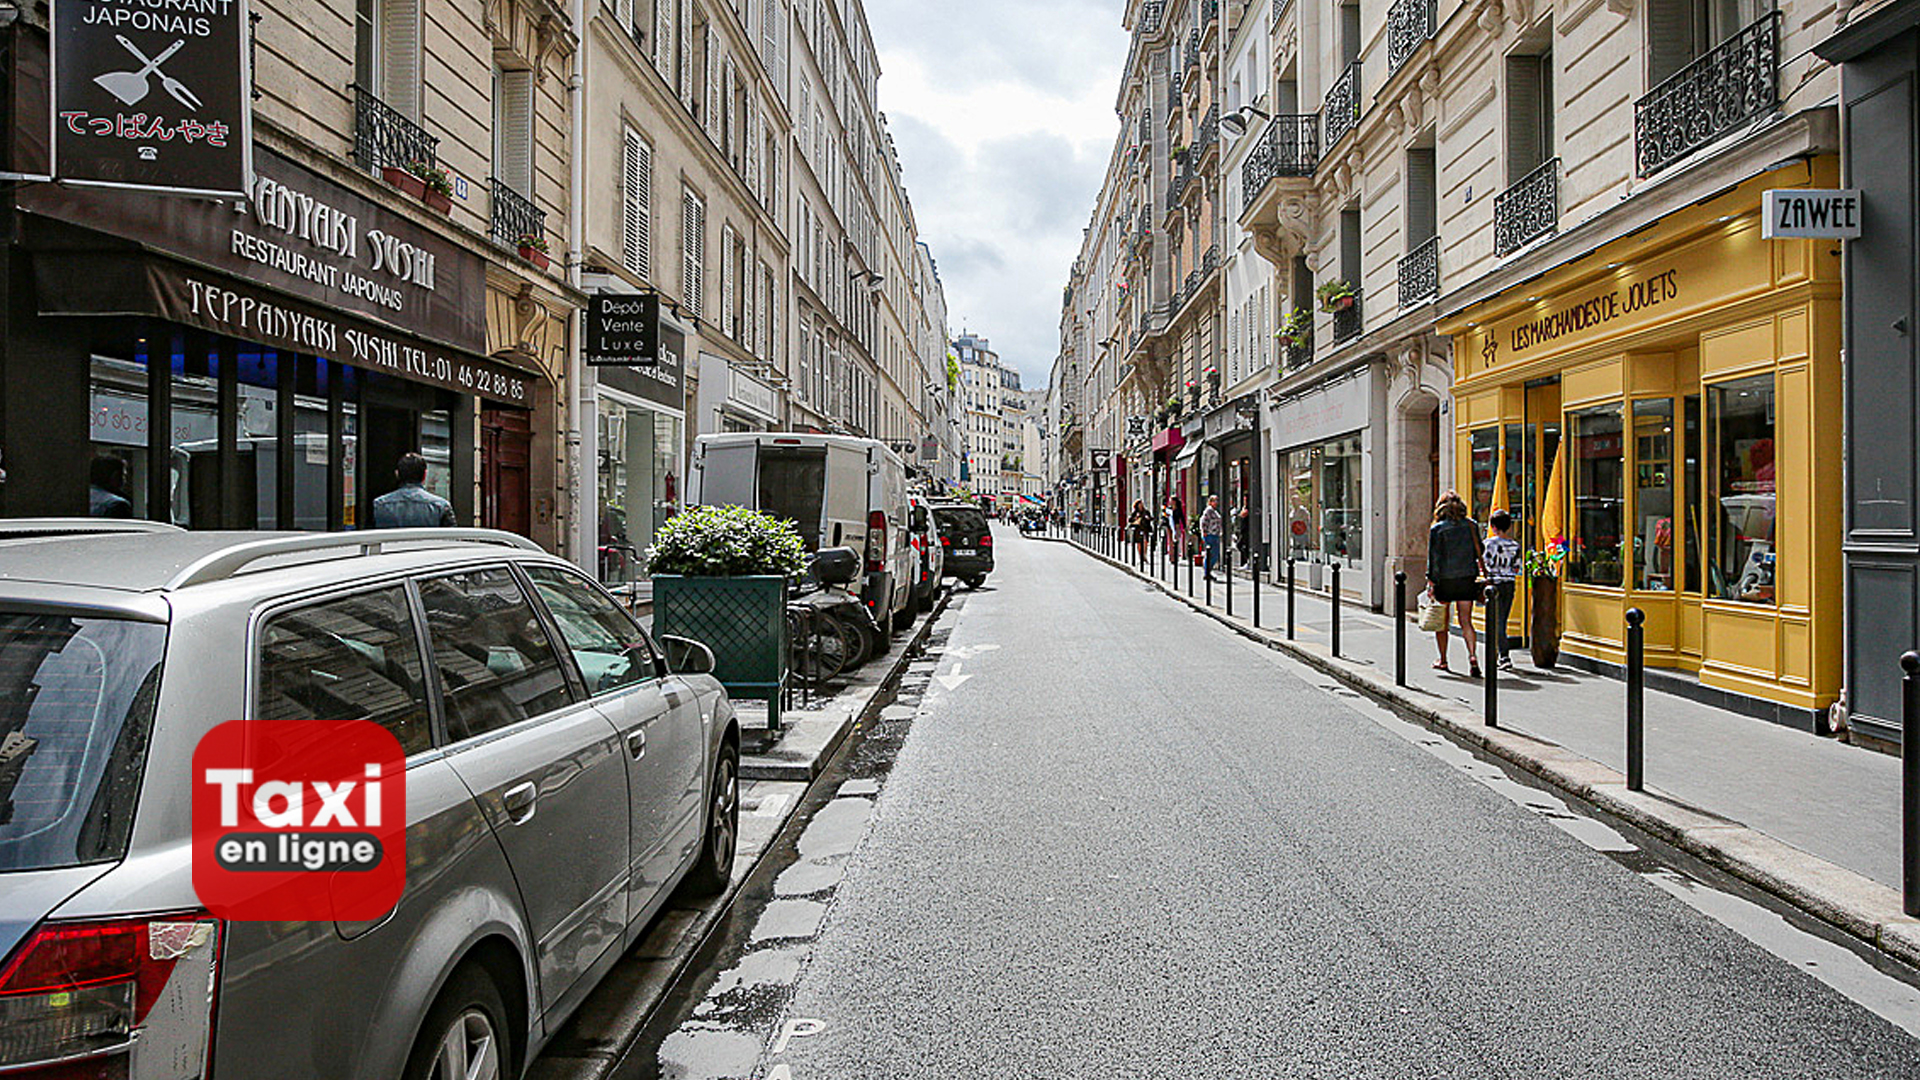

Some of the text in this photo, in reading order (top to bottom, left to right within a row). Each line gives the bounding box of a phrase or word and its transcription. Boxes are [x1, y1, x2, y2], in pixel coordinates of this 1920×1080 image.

[83, 5, 211, 36] JAPONAIS
[253, 174, 436, 291] ANYAKI SUSHI
[1778, 198, 1856, 229] ZAWEE
[231, 229, 403, 312] RESTAURANT JAPONAIS
[186, 278, 337, 352] TEPPANYAKI
[344, 329, 398, 369] SUSHI
[458, 364, 473, 388] 46
[476, 368, 491, 393] 22
[493, 373, 508, 397] 88
[601, 317, 644, 333] Vente
[1511, 268, 1678, 352] LES MARCHANDES DE JOUETS
[601, 336, 644, 351] Luxe
